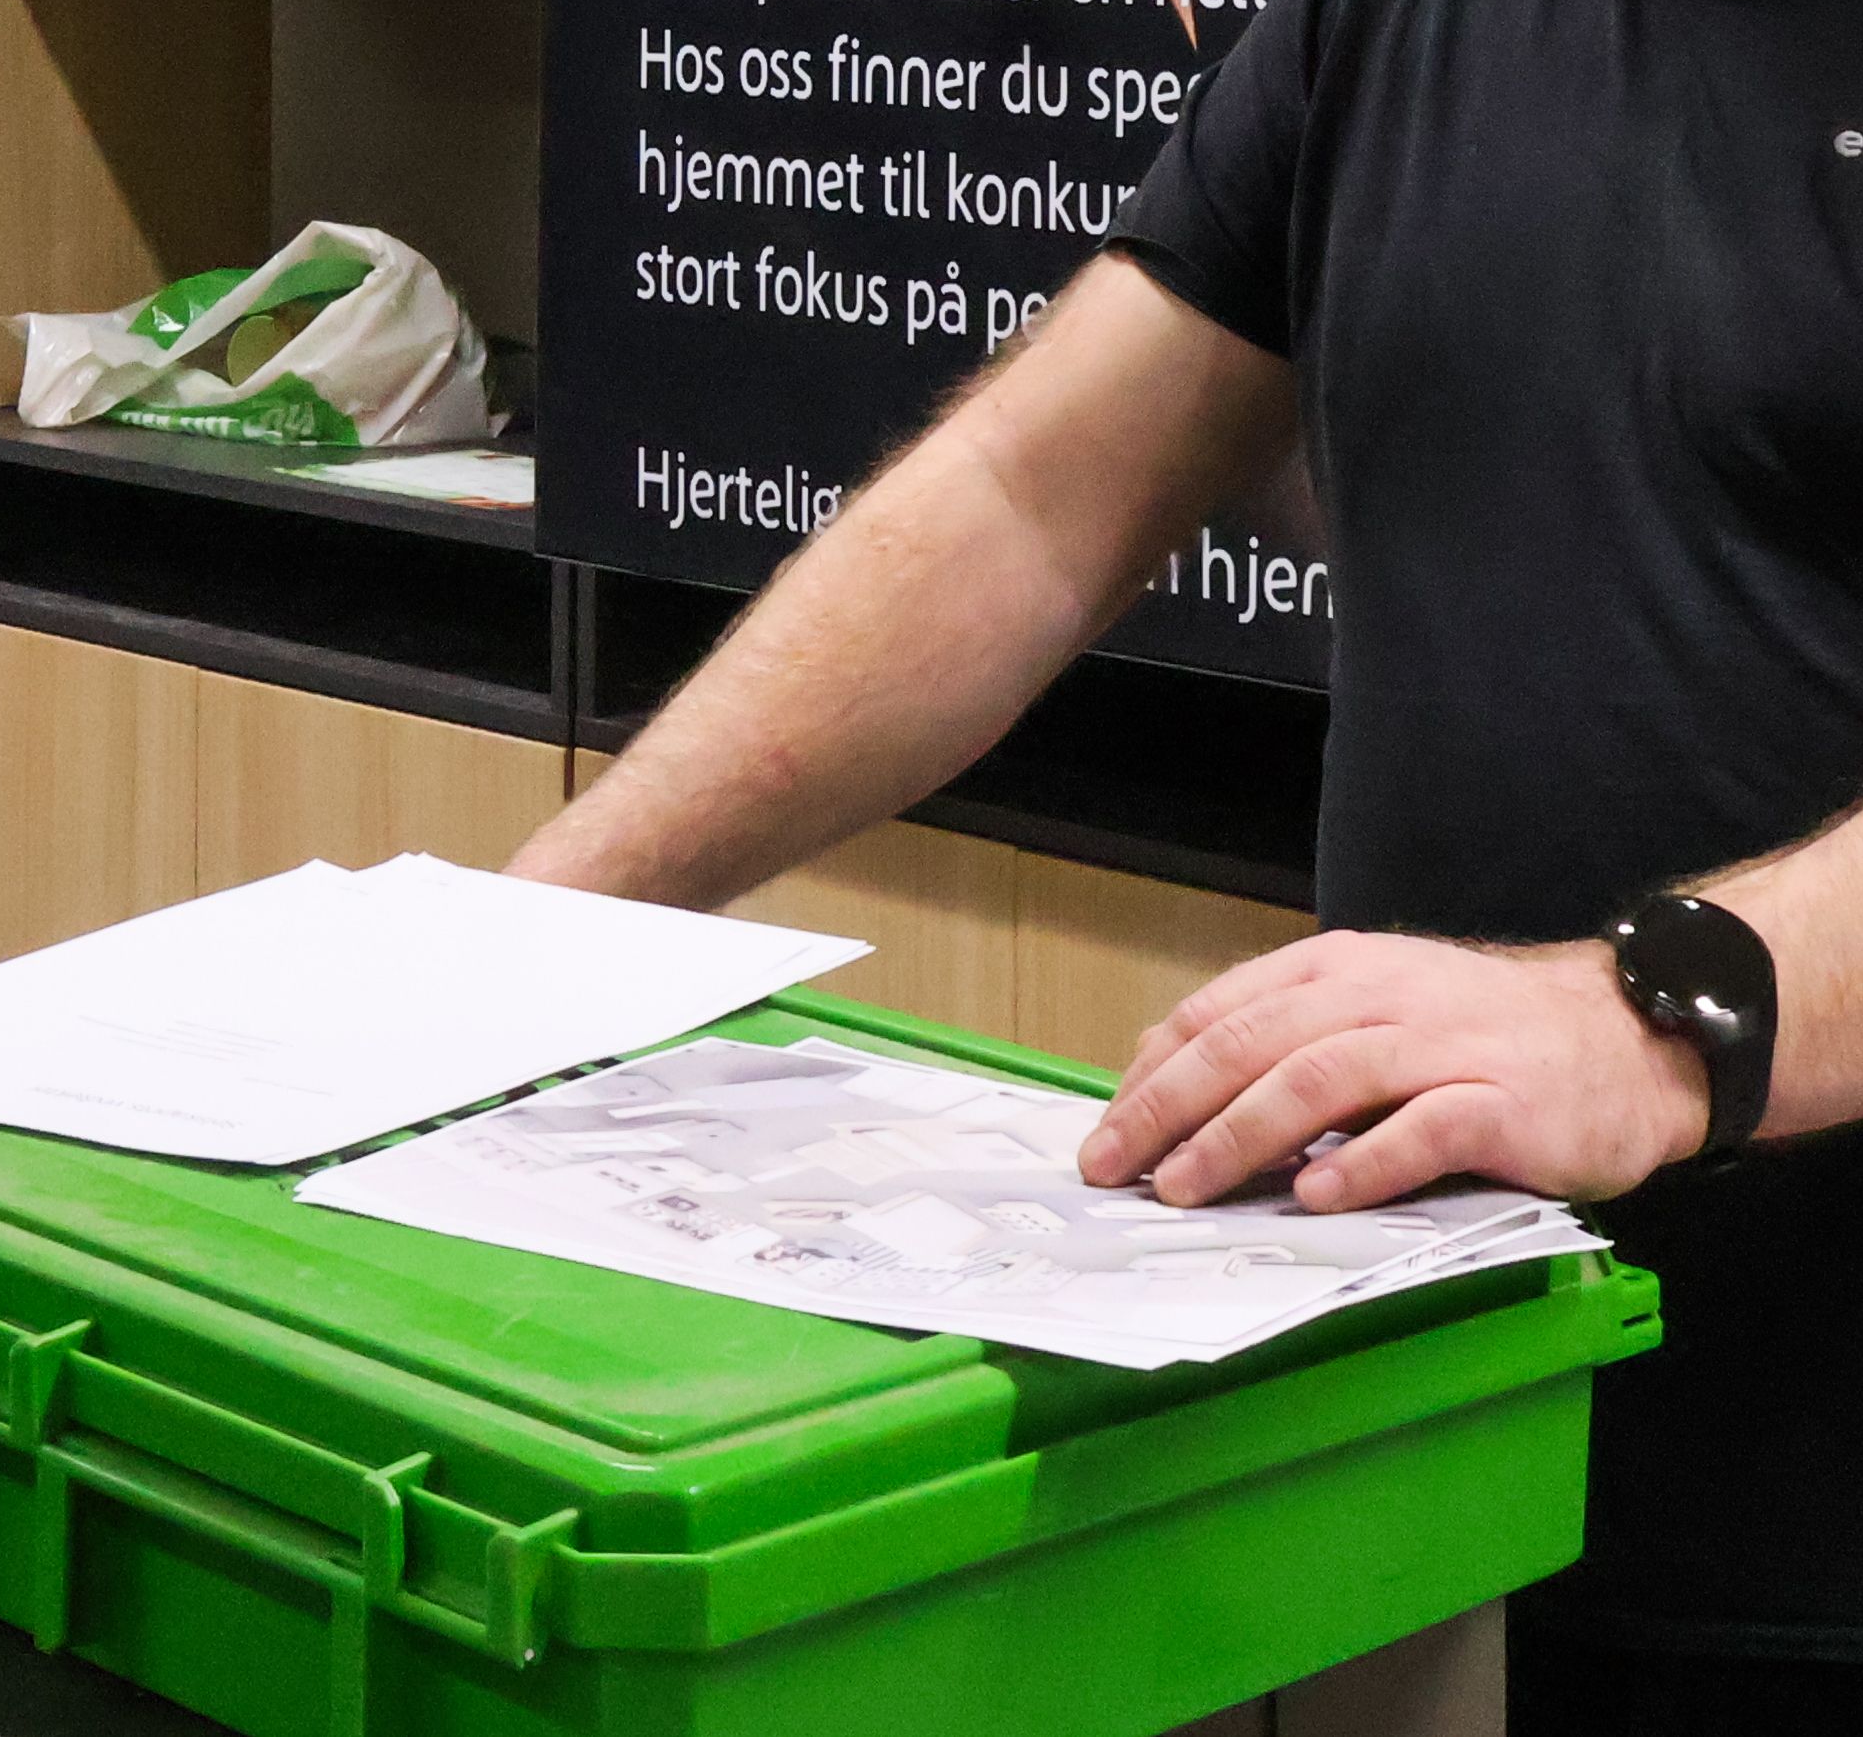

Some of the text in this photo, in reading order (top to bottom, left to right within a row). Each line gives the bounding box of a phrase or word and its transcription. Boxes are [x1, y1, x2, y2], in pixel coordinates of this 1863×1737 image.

[639, 26, 1203, 139] Hos oss finner du spe
[638, 128, 865, 215] hjemmet
[879, 149, 931, 220] til
[635, 244, 742, 311] stort
[754, 244, 890, 326] fokus
[906, 260, 968, 347] på
[637, 446, 843, 535] Hjertelig
